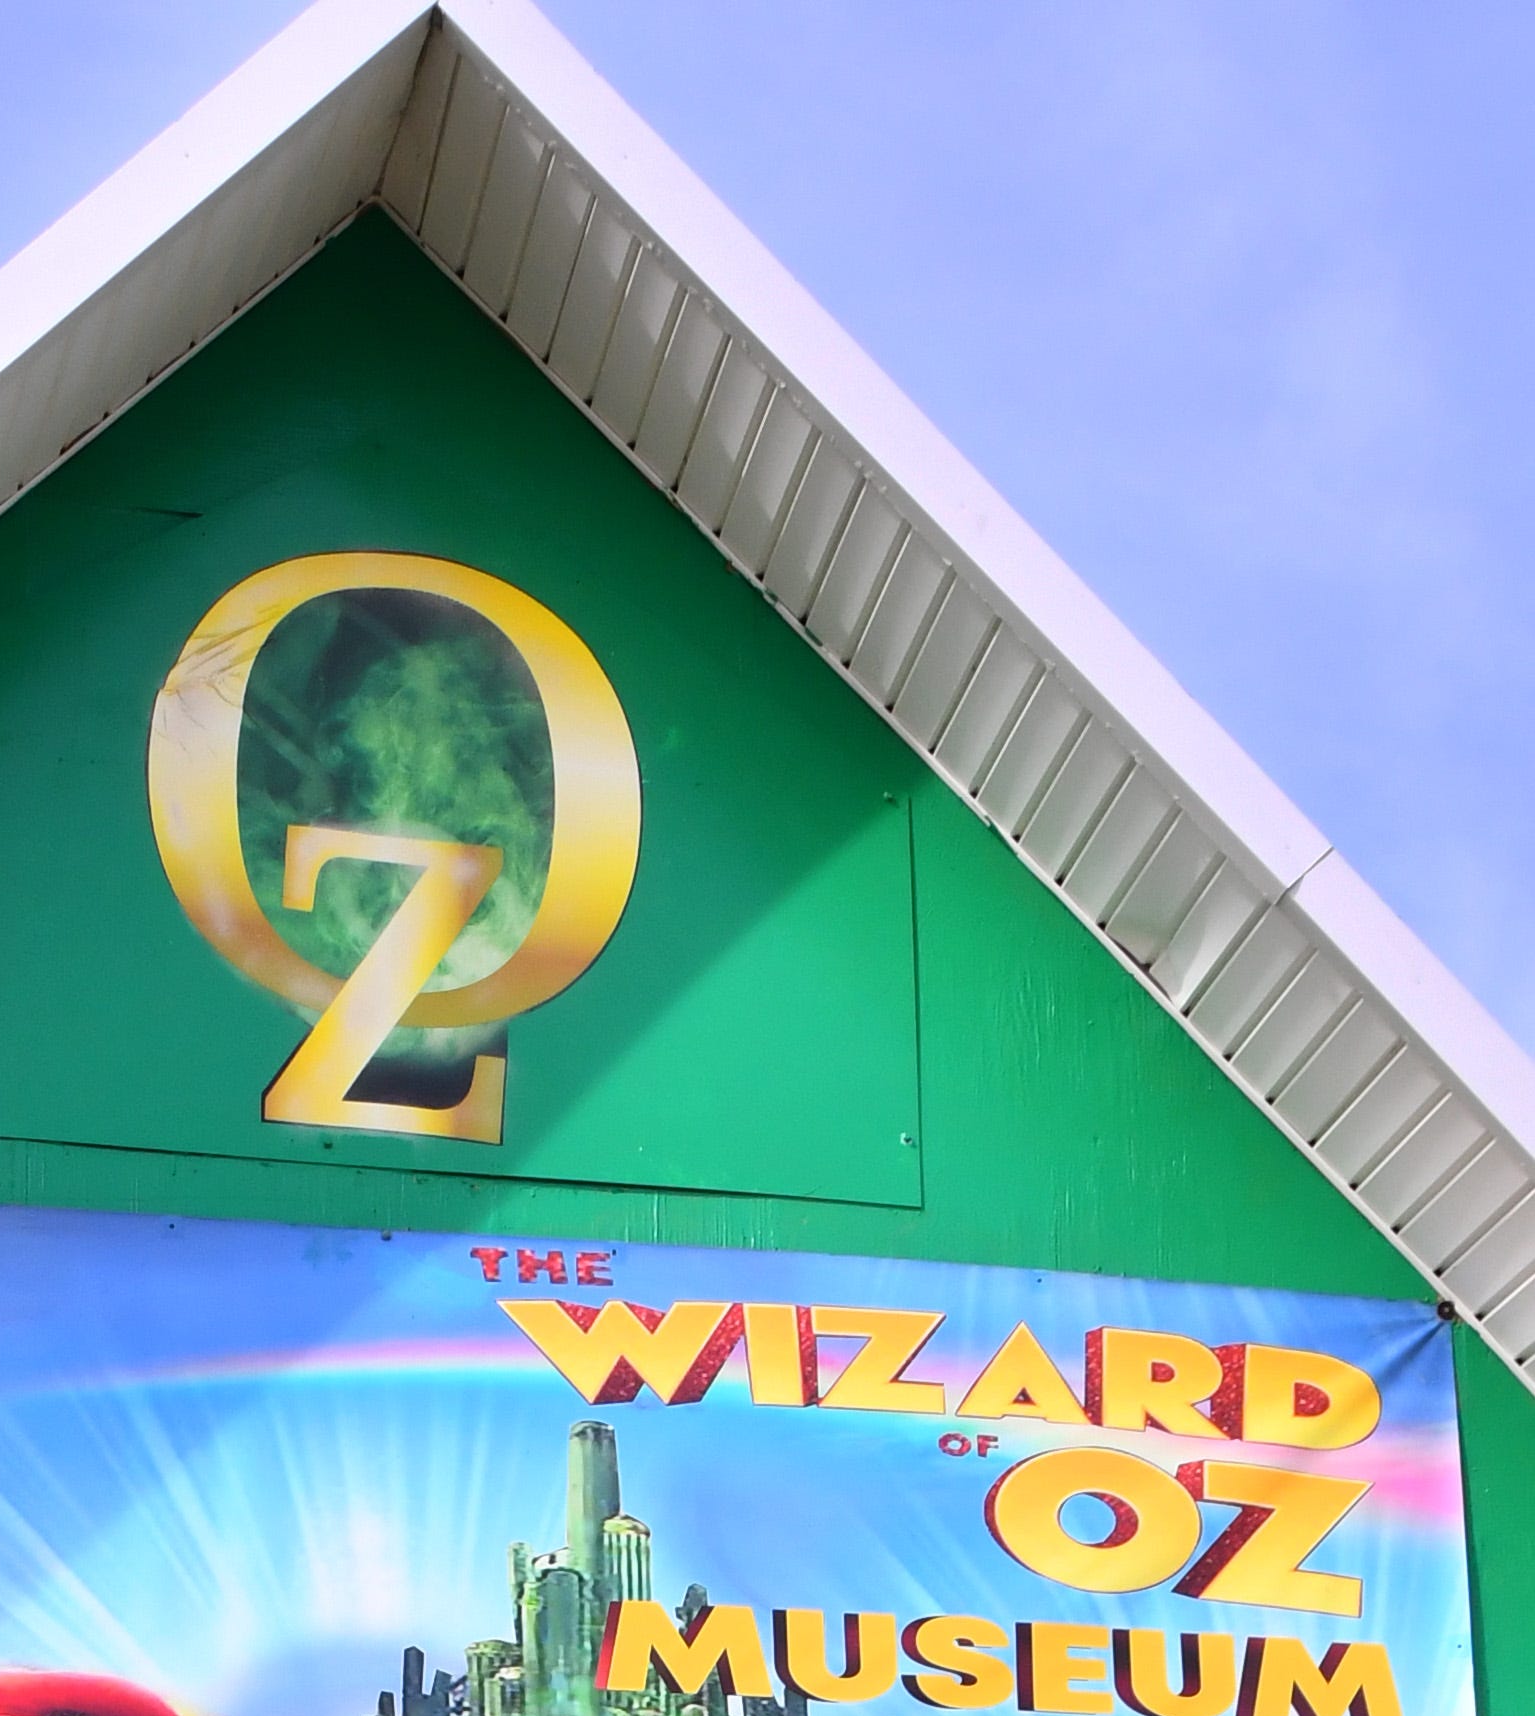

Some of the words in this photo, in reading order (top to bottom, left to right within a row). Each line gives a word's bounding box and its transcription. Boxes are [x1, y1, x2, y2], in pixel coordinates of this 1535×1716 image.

[470, 1246, 614, 1287] THE
[495, 1298, 1383, 1452] WIZARD
[938, 1432, 1000, 1459] OF
[983, 1446, 1376, 1619] OZ
